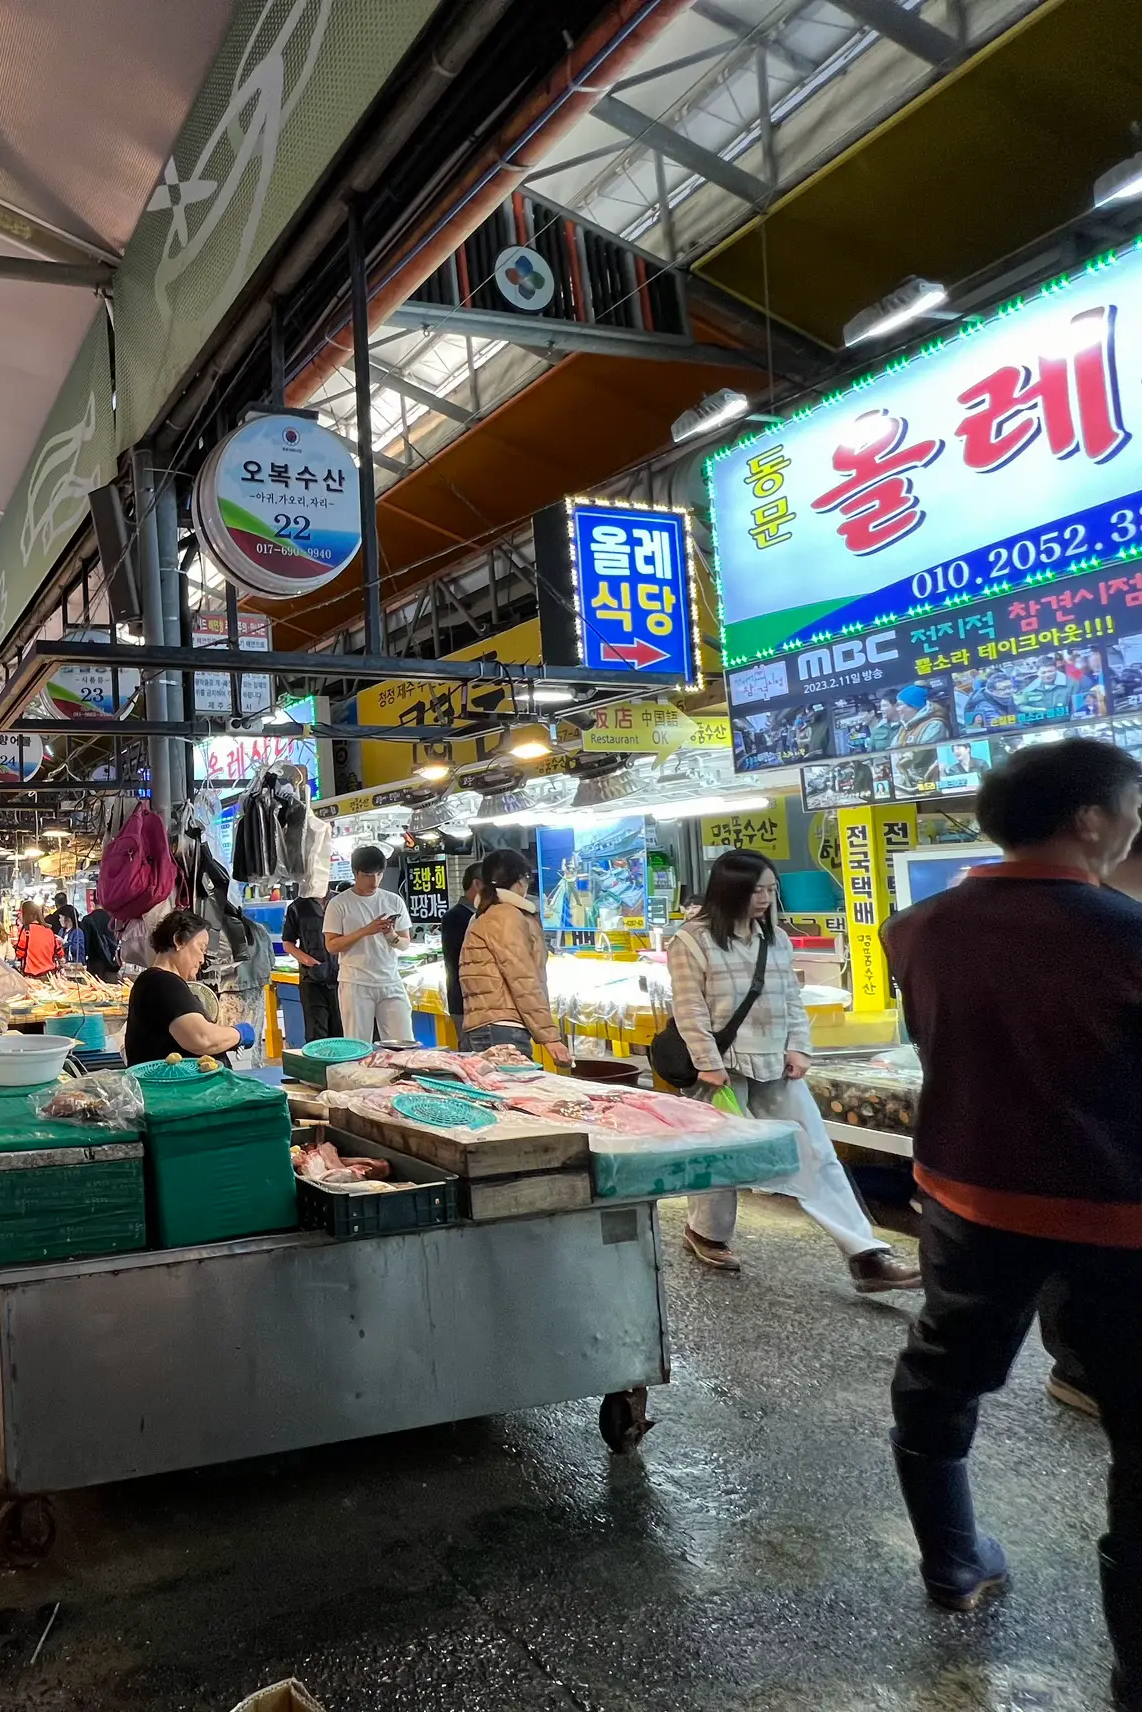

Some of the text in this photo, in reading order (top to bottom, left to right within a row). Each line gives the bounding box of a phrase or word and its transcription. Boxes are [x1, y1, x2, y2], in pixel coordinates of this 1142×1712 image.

[811, 304, 1132, 557] 올레
[240, 460, 346, 494] 오복수산
[745, 445, 797, 550] 동문
[273, 513, 311, 541] 22
[590, 525, 673, 580] 올레
[591, 581, 677, 636] 식당
[910, 572, 1142, 653] 전지적 참견시점
[797, 630, 899, 681] MBC
[914, 615, 1116, 676] 뿔소라 테이크아웃!!!
[80, 687, 104, 702] 23
[377, 686, 395, 708] 청정
[396, 682, 416, 700] 제주
[861, 669, 884, 683] 방송
[590, 730, 669, 745] Restaurant OK
[0, 755, 16, 767] 24
[710, 815, 778, 850] 명품수산
[845, 824, 876, 926] 전국택배
[409, 893, 448, 919] 포장가능
[856, 934, 877, 996] 명품수산
